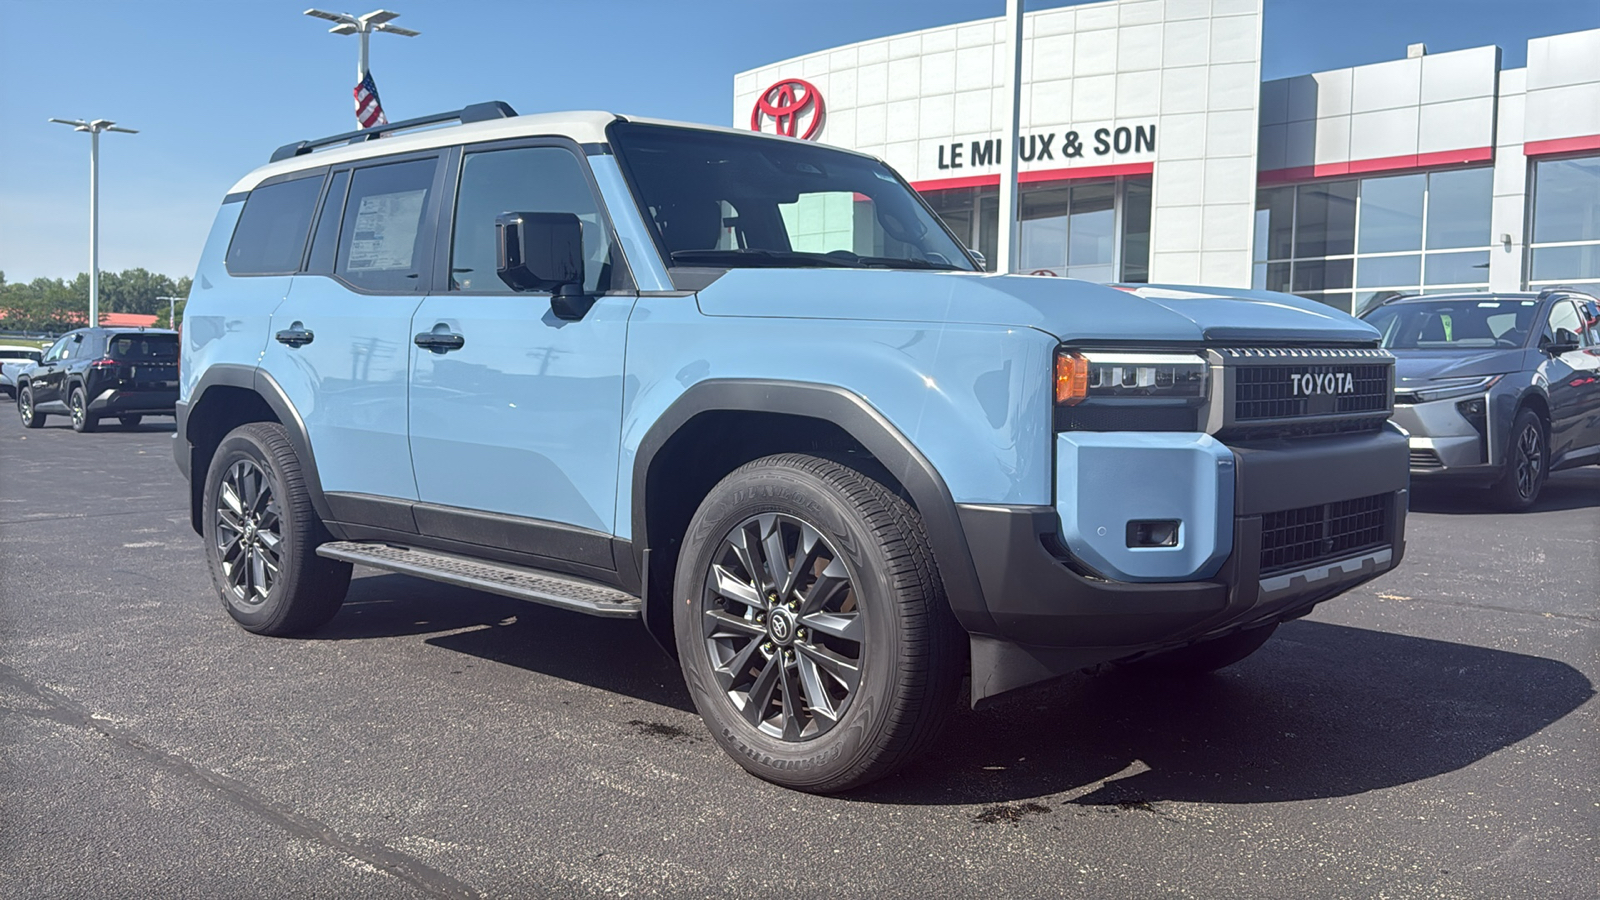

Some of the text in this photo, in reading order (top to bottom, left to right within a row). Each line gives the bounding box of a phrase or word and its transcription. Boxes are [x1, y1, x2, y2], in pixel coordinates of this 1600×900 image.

[938, 124, 1156, 169] LE MIUX & SON
[1291, 373, 1354, 395] TOYOTA
[732, 484, 823, 513] DUNLOP
